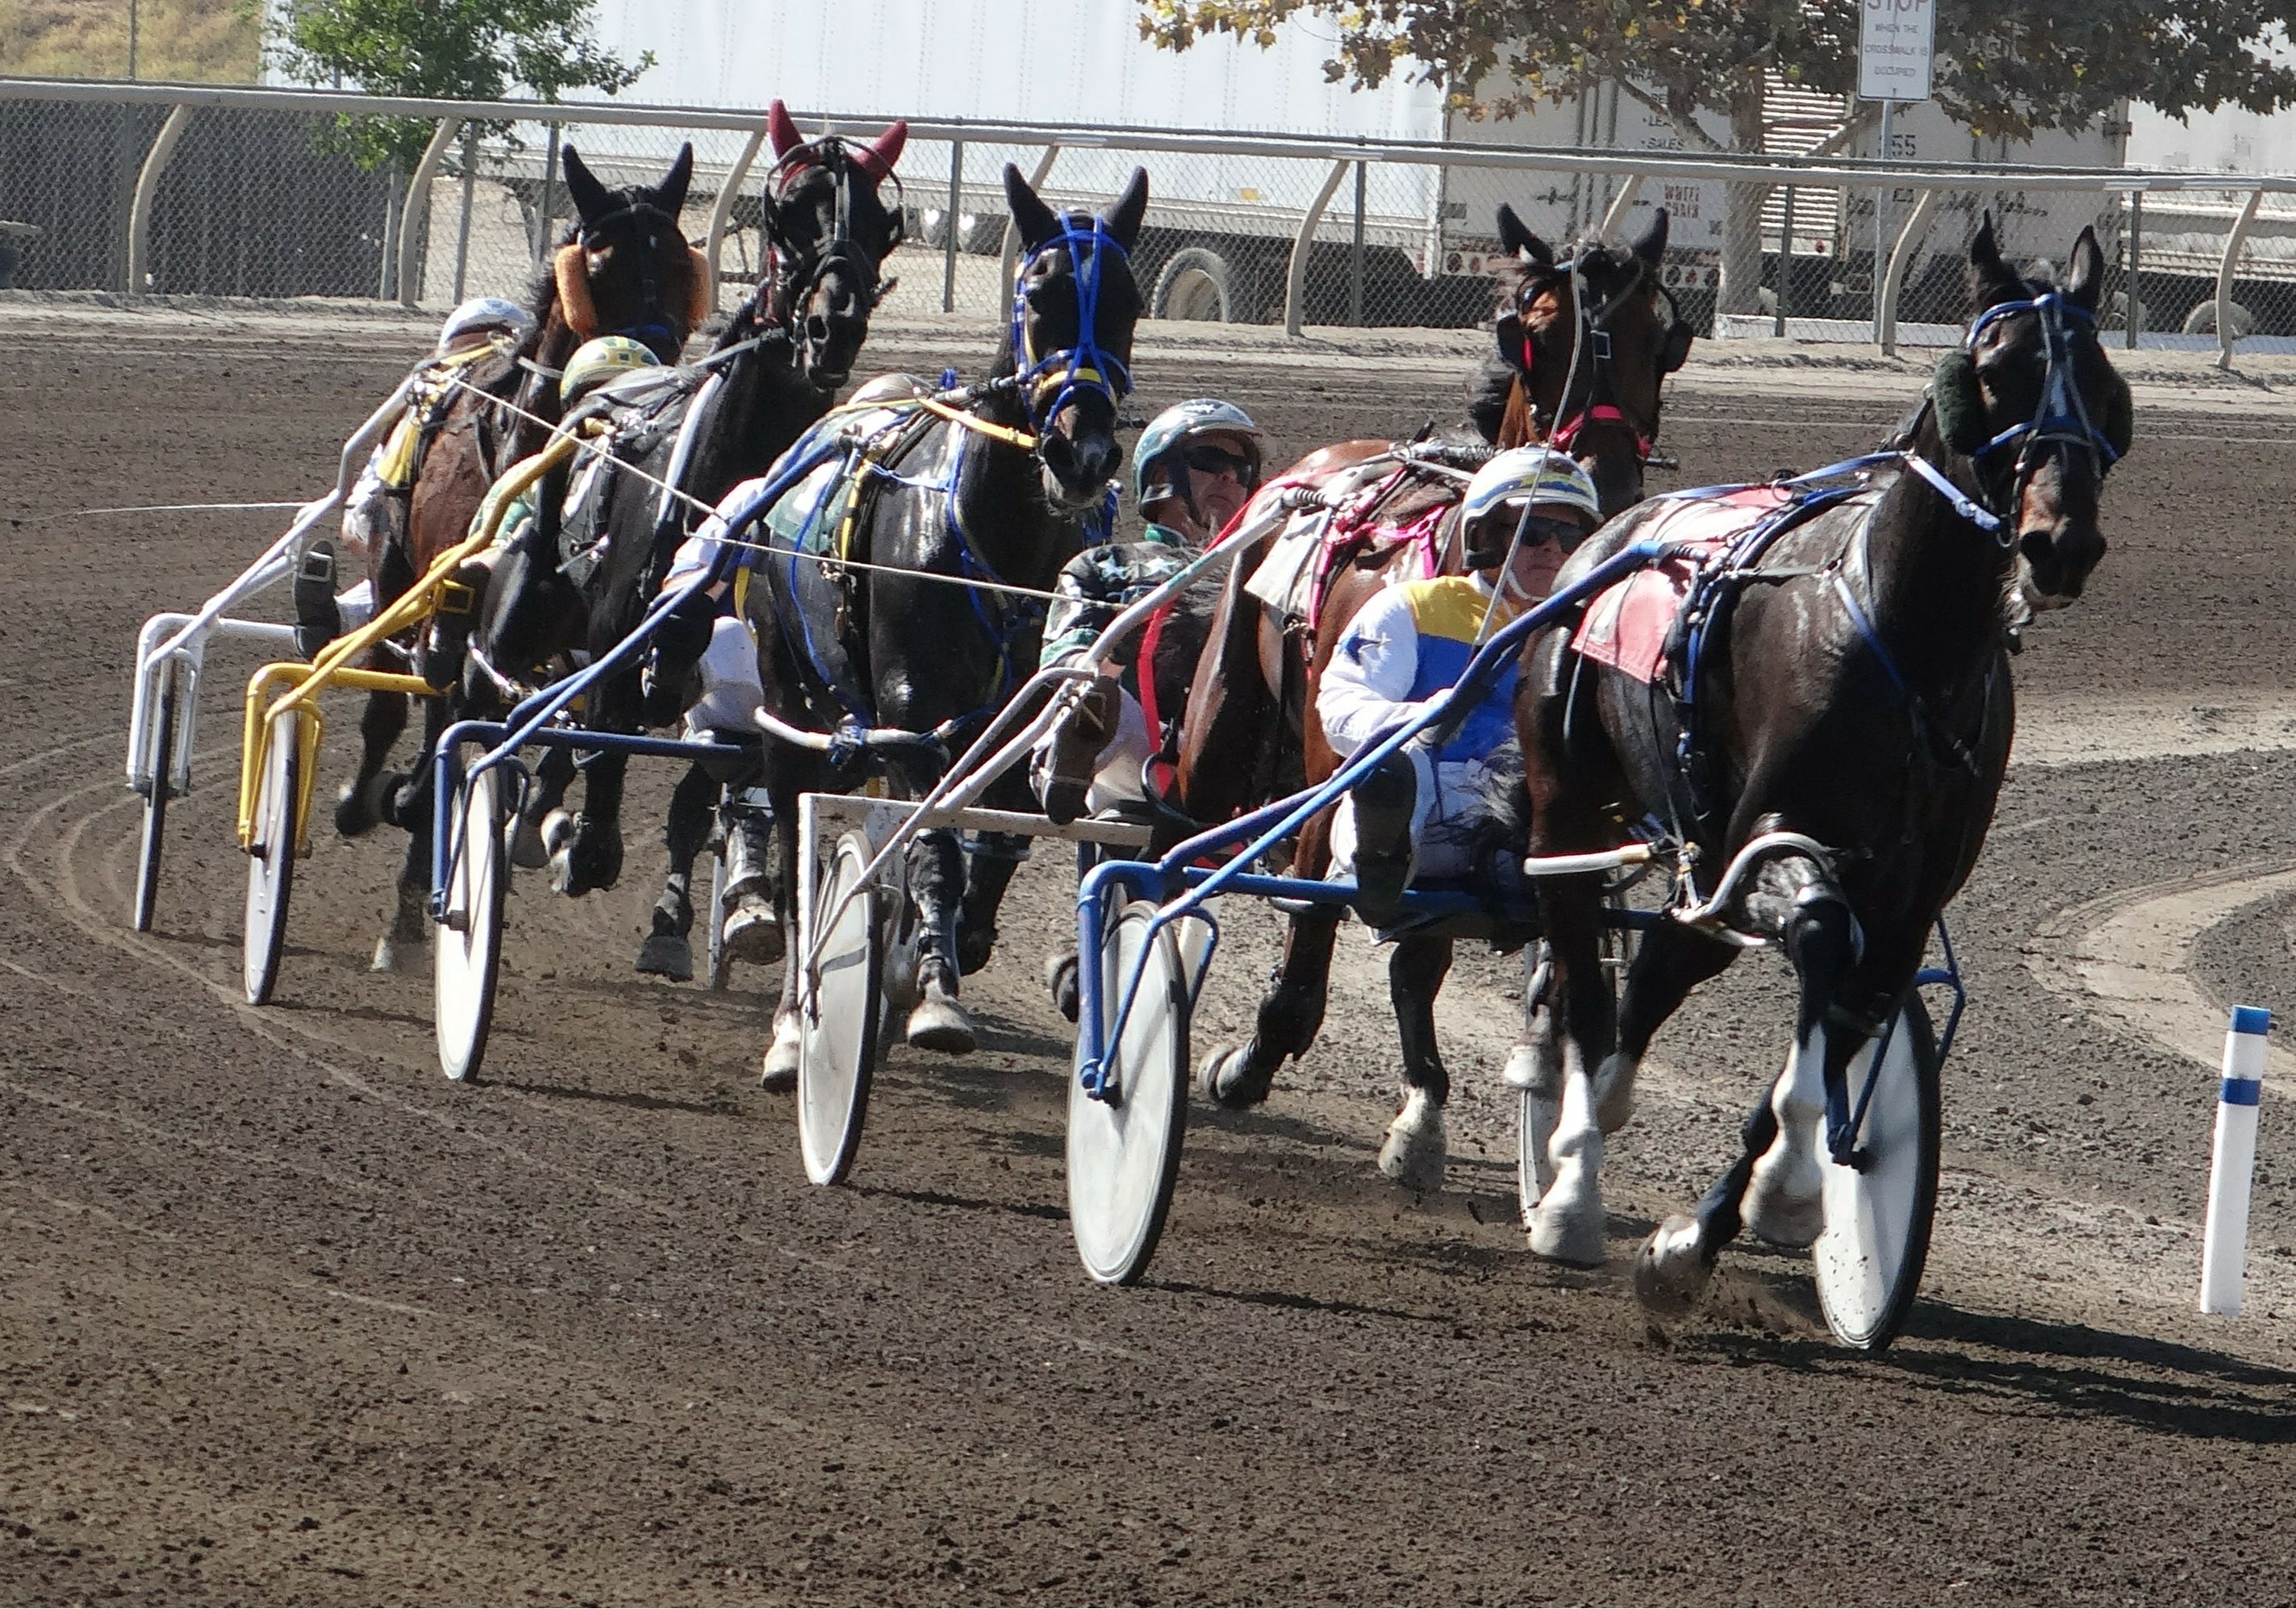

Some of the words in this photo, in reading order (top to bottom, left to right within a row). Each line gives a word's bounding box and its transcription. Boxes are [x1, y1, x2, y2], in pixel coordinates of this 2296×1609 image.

[1875, 24, 1901, 33] WHEN
[1903, 24, 1918, 34] THE
[1864, 44, 1917, 56] CROSSWALK
[1647, 137, 1686, 151] SALES
